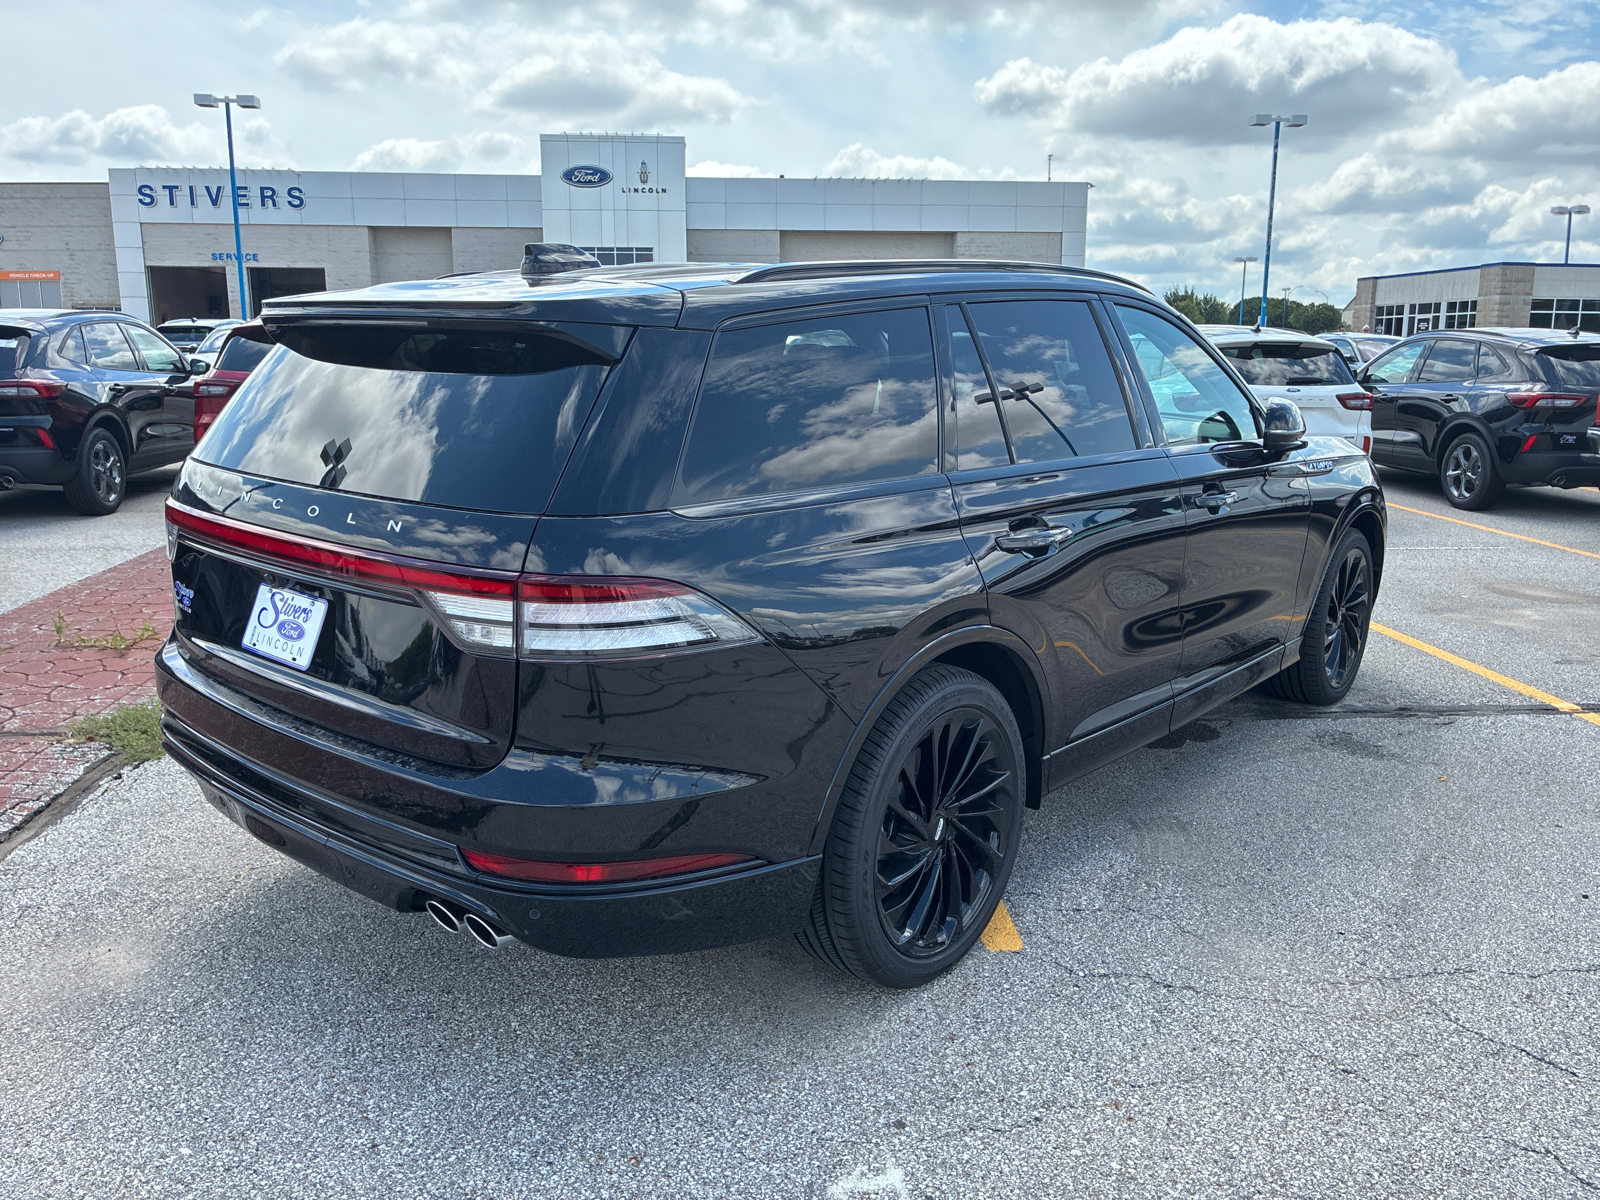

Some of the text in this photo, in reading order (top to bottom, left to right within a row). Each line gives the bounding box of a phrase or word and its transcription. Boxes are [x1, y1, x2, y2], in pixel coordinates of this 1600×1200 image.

[571, 168, 601, 182] Ford
[137, 184, 304, 208] STIVERS
[196, 480, 402, 533] LINCOLN
[257, 591, 313, 629] Stivers
[281, 621, 301, 638] Ford
[256, 632, 305, 658] LINCOLN
